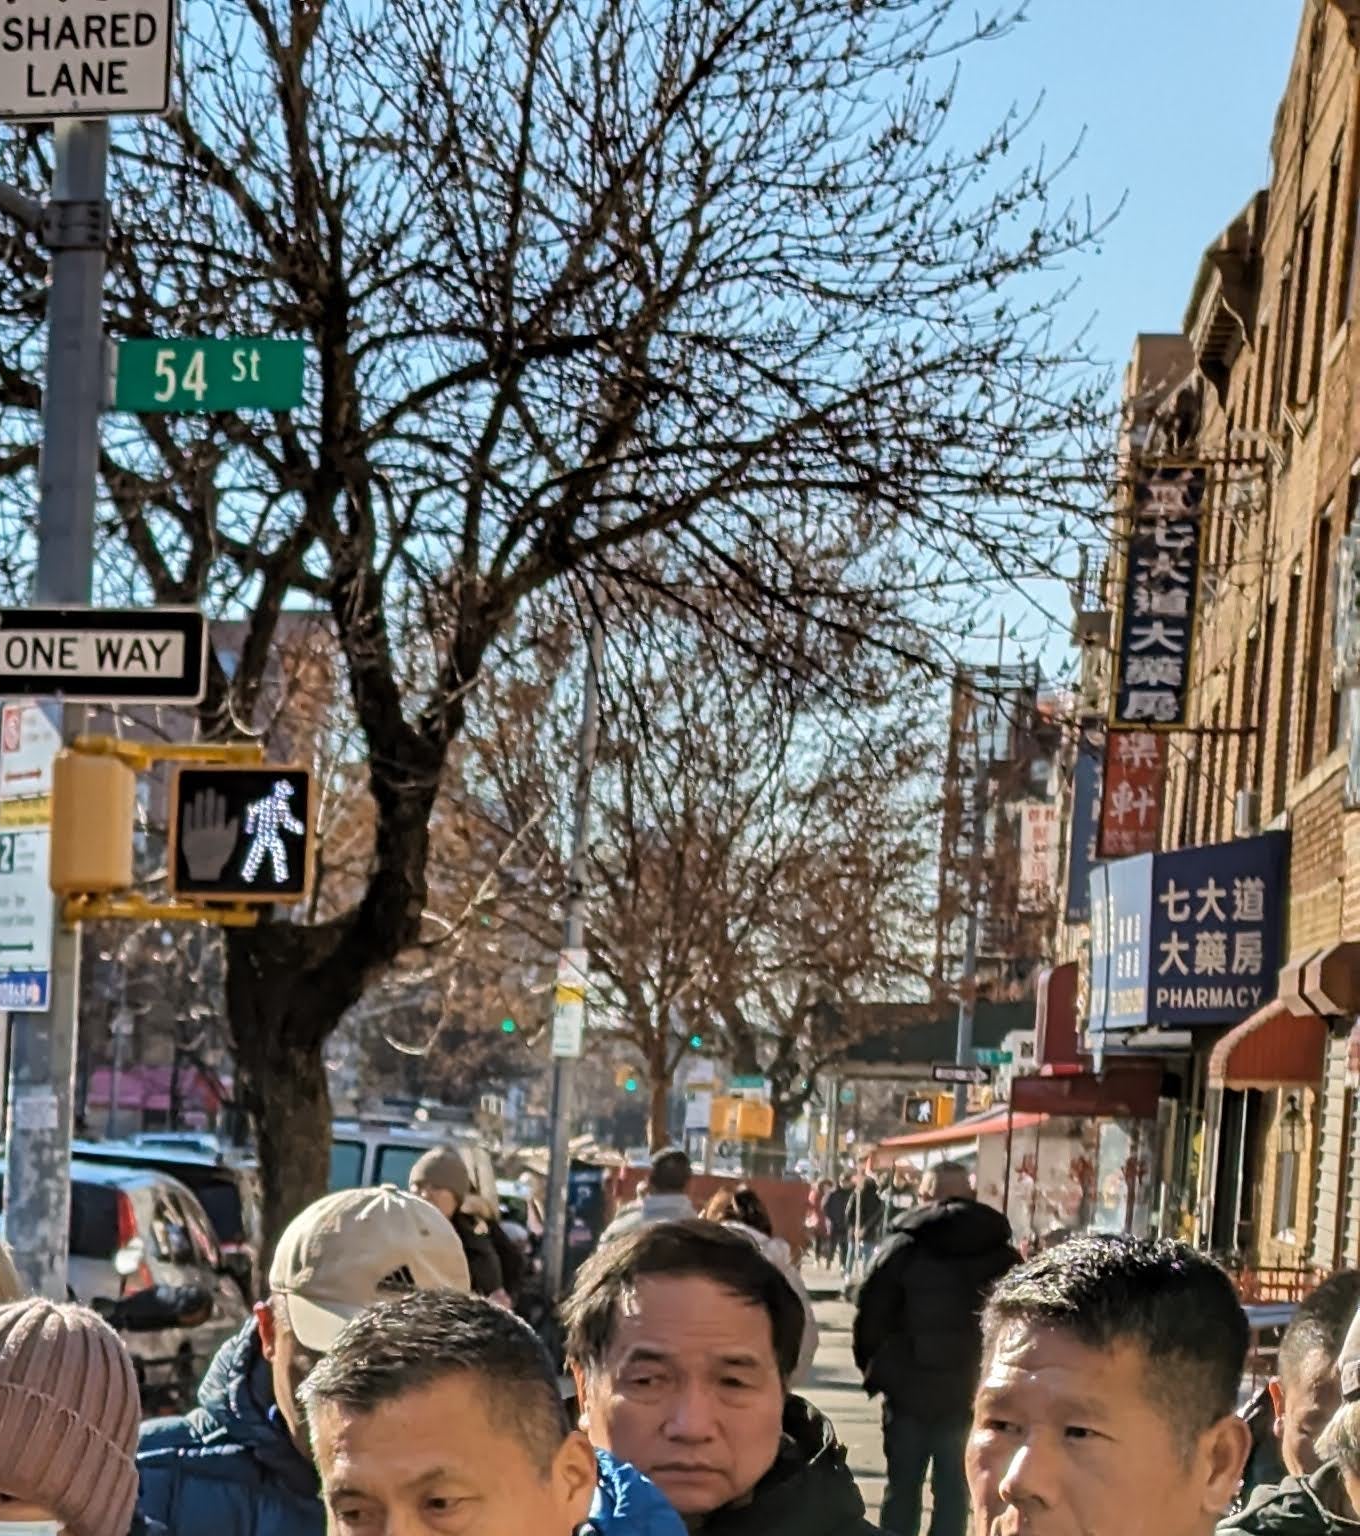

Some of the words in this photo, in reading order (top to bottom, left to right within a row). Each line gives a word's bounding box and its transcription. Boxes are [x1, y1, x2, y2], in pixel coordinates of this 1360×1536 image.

[2, 12, 157, 51] SHARED
[26, 60, 129, 98] LANE
[154, 349, 208, 403] 54
[231, 349, 261, 384] St
[5, 637, 78, 671] ONE
[93, 636, 173, 672] WAY
[0, 835, 12, 872] 2
[1158, 875, 1265, 925] 七大道
[1156, 930, 1264, 978] 大藥房
[1156, 984, 1262, 1010] PHARMACY
